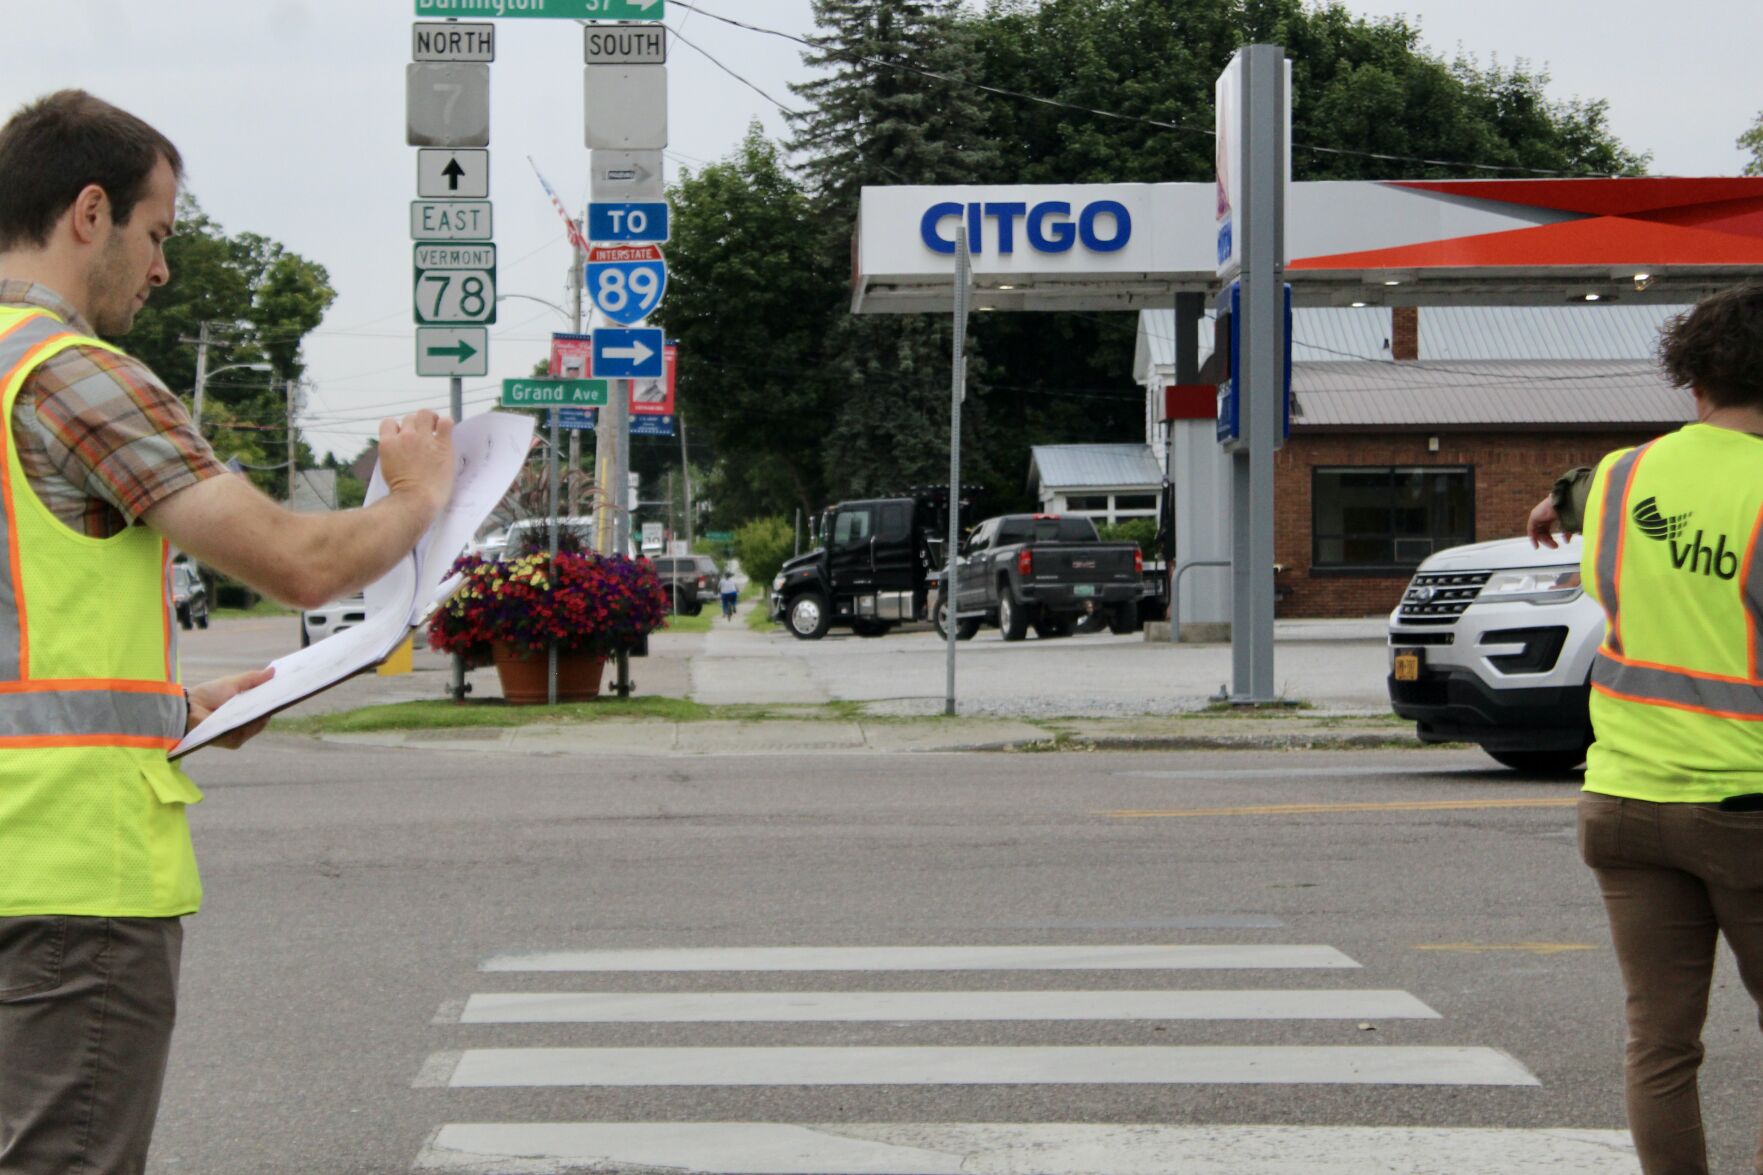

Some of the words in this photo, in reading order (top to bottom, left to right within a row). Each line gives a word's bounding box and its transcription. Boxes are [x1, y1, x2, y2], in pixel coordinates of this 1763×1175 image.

[417, 32, 492, 54] NORTH
[589, 34, 660, 55] SOUTH
[423, 206, 480, 231] EAST
[607, 211, 648, 233] TO
[920, 200, 1132, 254] CITGO
[420, 250, 490, 265] VERMONT
[596, 249, 653, 260] INTERSTATE
[425, 276, 485, 317] 78
[598, 267, 658, 312] 89
[512, 384, 564, 401] Grand
[572, 387, 599, 401] Ave
[1670, 529, 1737, 580] vhb
